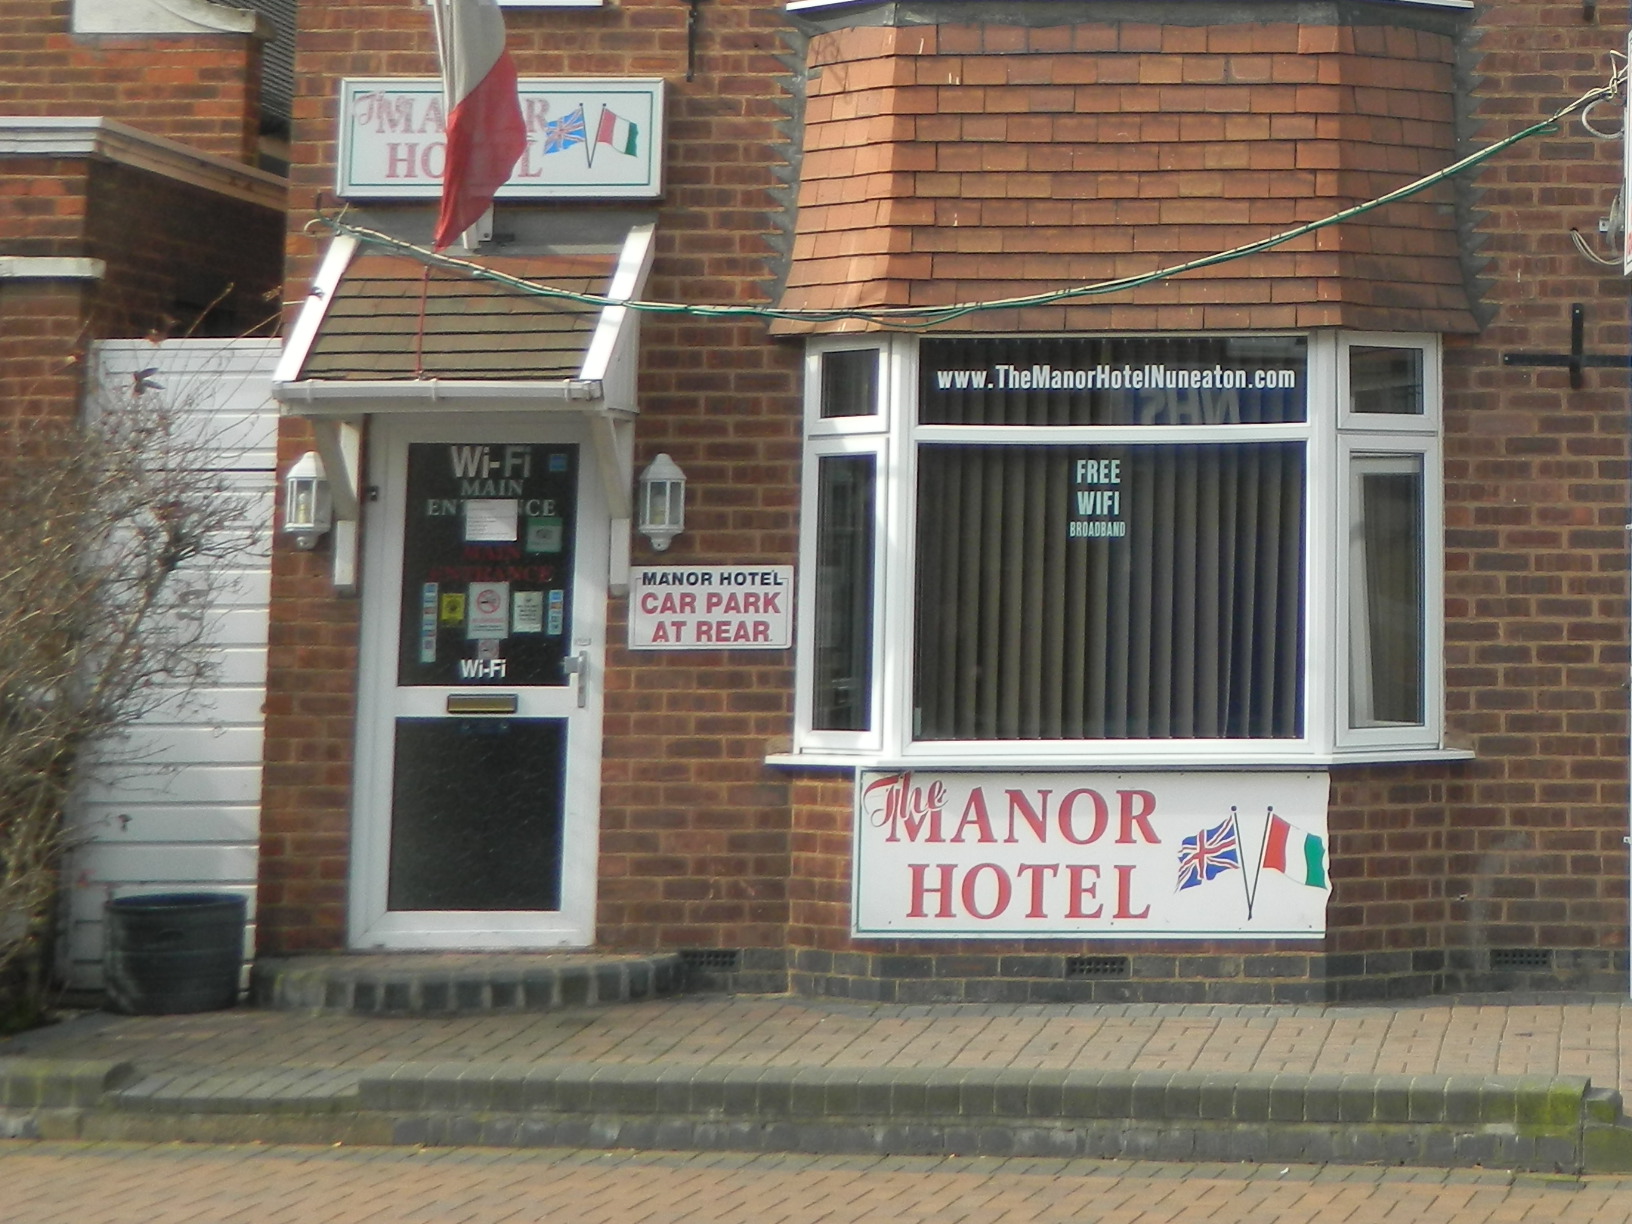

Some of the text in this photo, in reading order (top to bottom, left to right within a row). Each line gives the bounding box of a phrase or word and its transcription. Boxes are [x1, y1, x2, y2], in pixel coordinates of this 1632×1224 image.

[375, 96, 551, 134] MAR
[385, 141, 543, 178] HOL
[937, 364, 1296, 390] www.TheManorHotelNuneaton.com
[451, 445, 532, 478] Wi-Fi
[1076, 459, 1121, 484] FREE
[460, 479, 523, 496] MAIN
[1077, 490, 1120, 516] WIFI
[1069, 521, 1126, 538] BROADBAND
[642, 571, 784, 587] MANOR HOTEL
[641, 592, 782, 614] CAR PARK
[651, 620, 771, 643] AT REAR
[460, 659, 506, 678] Wi-Fi
[863, 770, 949, 828] The
[884, 785, 1162, 844] MANOR
[905, 862, 1151, 920] HOTEL
